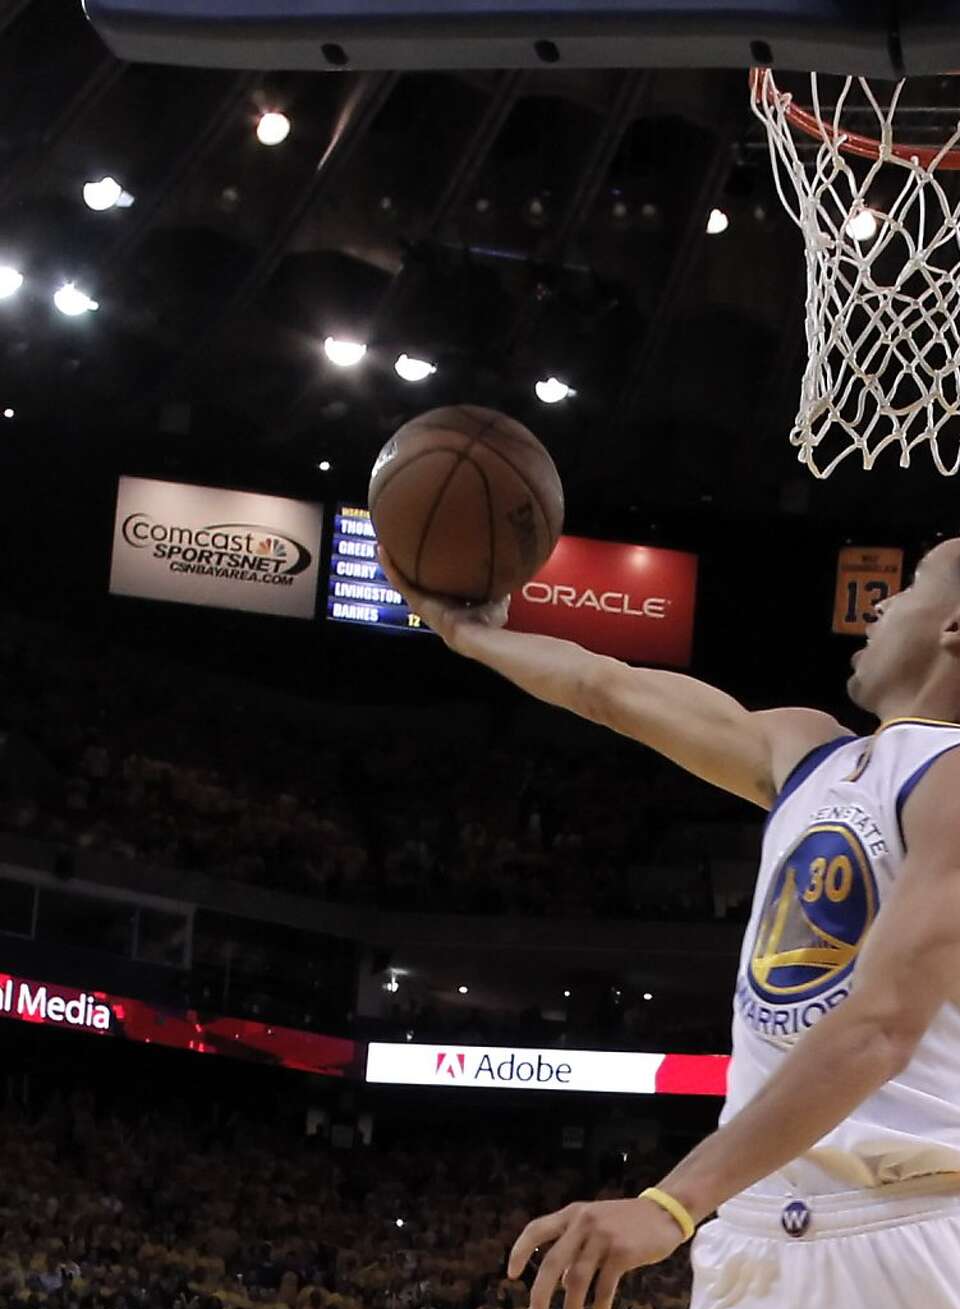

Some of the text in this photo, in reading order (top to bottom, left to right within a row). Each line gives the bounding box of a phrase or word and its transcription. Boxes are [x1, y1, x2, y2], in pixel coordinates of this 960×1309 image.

[153, 543, 288, 574] SPORTSNET
[338, 540, 376, 559] GREEN
[169, 561, 295, 587] CSNBAYAREA.COM
[336, 561, 378, 580] CURRY
[334, 582, 403, 605] LIVINGSTON
[521, 581, 667, 619] ORACLE
[332, 602, 379, 623] BARNES
[803, 854, 854, 903] 30
[17, 983, 111, 1029] Media
[474, 1051, 572, 1083] Adobe
